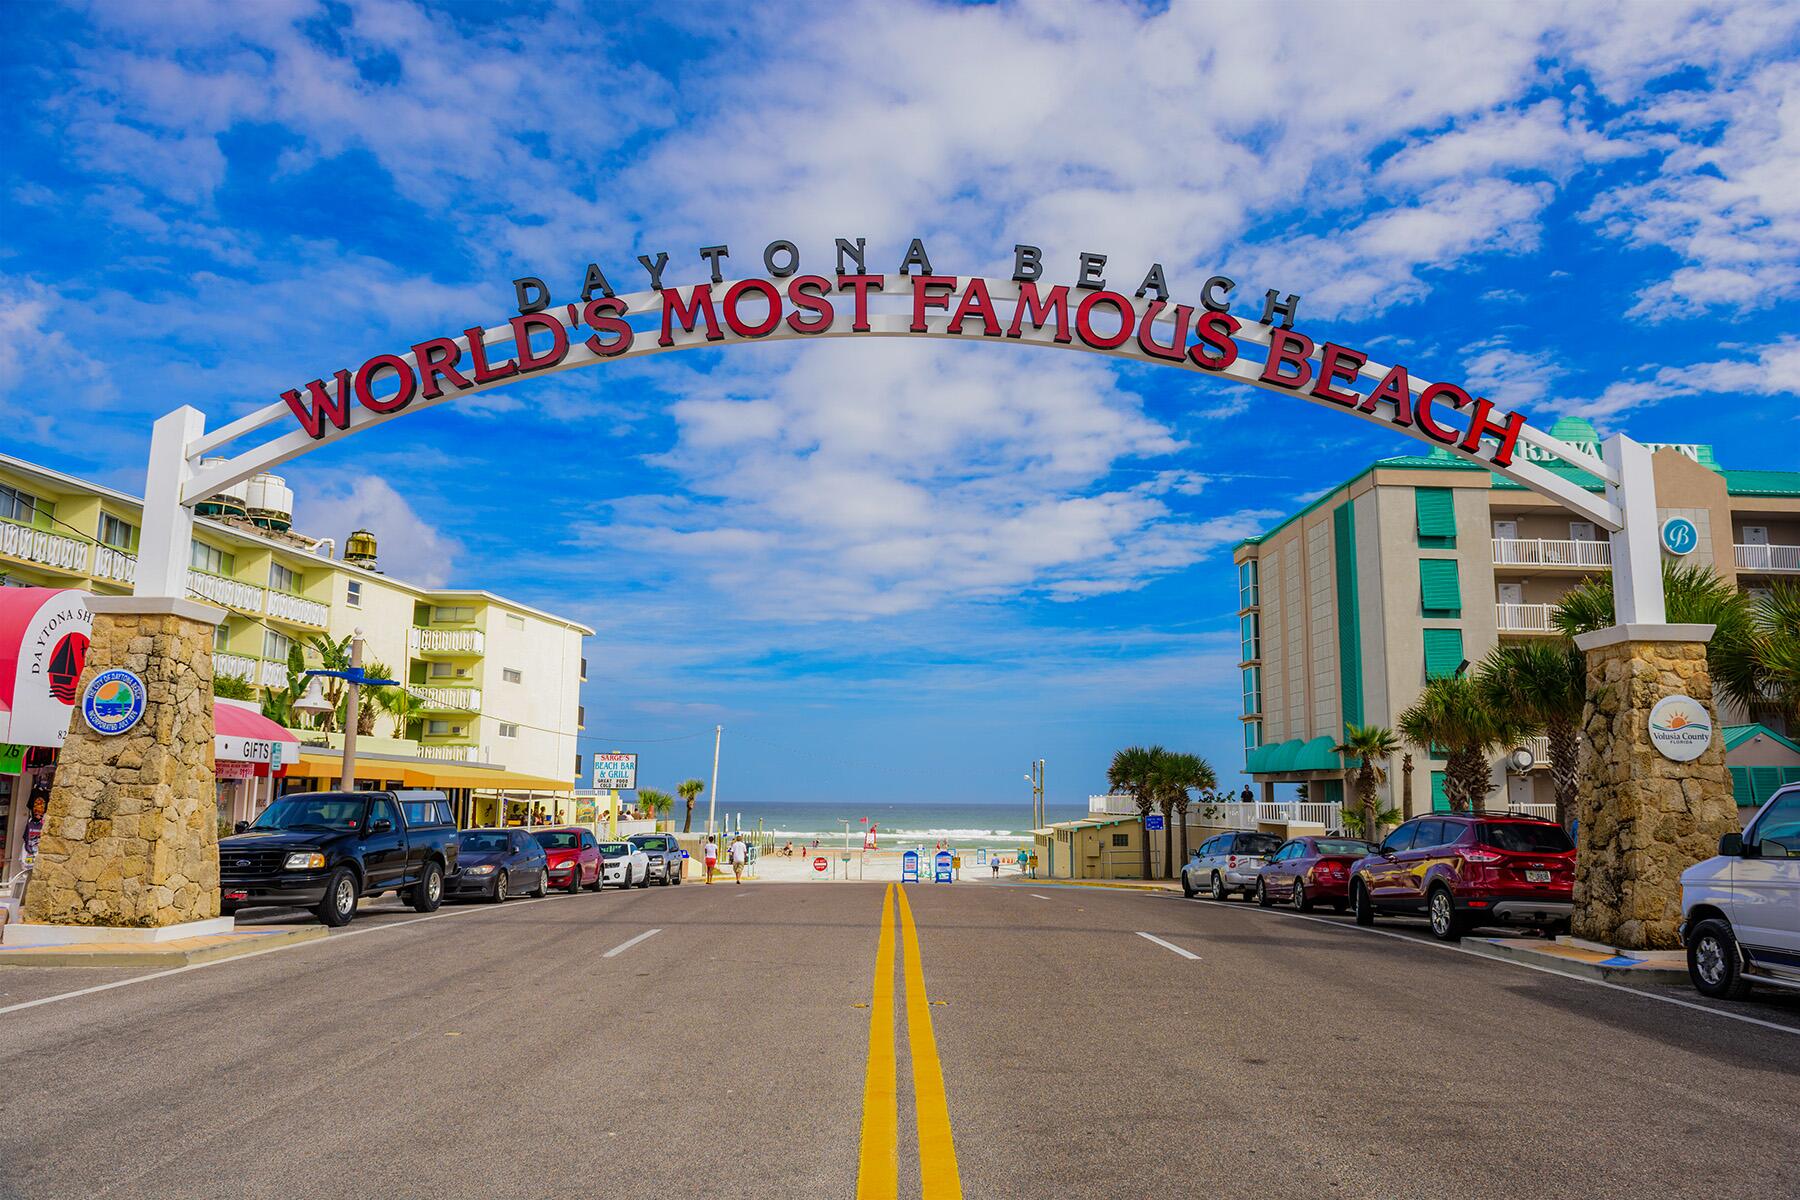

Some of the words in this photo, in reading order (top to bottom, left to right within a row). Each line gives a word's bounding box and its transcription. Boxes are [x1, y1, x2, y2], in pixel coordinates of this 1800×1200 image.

[512, 238, 933, 314] DAYTONA
[1012, 244, 1301, 330] BEACH
[280, 296, 634, 439] WORLD'S
[658, 274, 884, 347] MOST
[910, 275, 1243, 371] FAMOUS
[1258, 326, 1527, 468] BEACH
[31, 609, 73, 673] DAYTONA
[77, 608, 92, 624] SH
[87, 687, 97, 698] THE
[94, 679, 104, 690] CITY
[104, 673, 111, 681] OF
[111, 673, 133, 685] DAYTONA
[1653, 732, 1680, 740] Volusia
[1682, 732, 1709, 742] County
[243, 741, 270, 759] GIFTS
[595, 762, 618, 770] BEACH
[620, 762, 634, 770] BAR
[600, 770, 606, 778] &
[608, 770, 629, 778] GRILL
